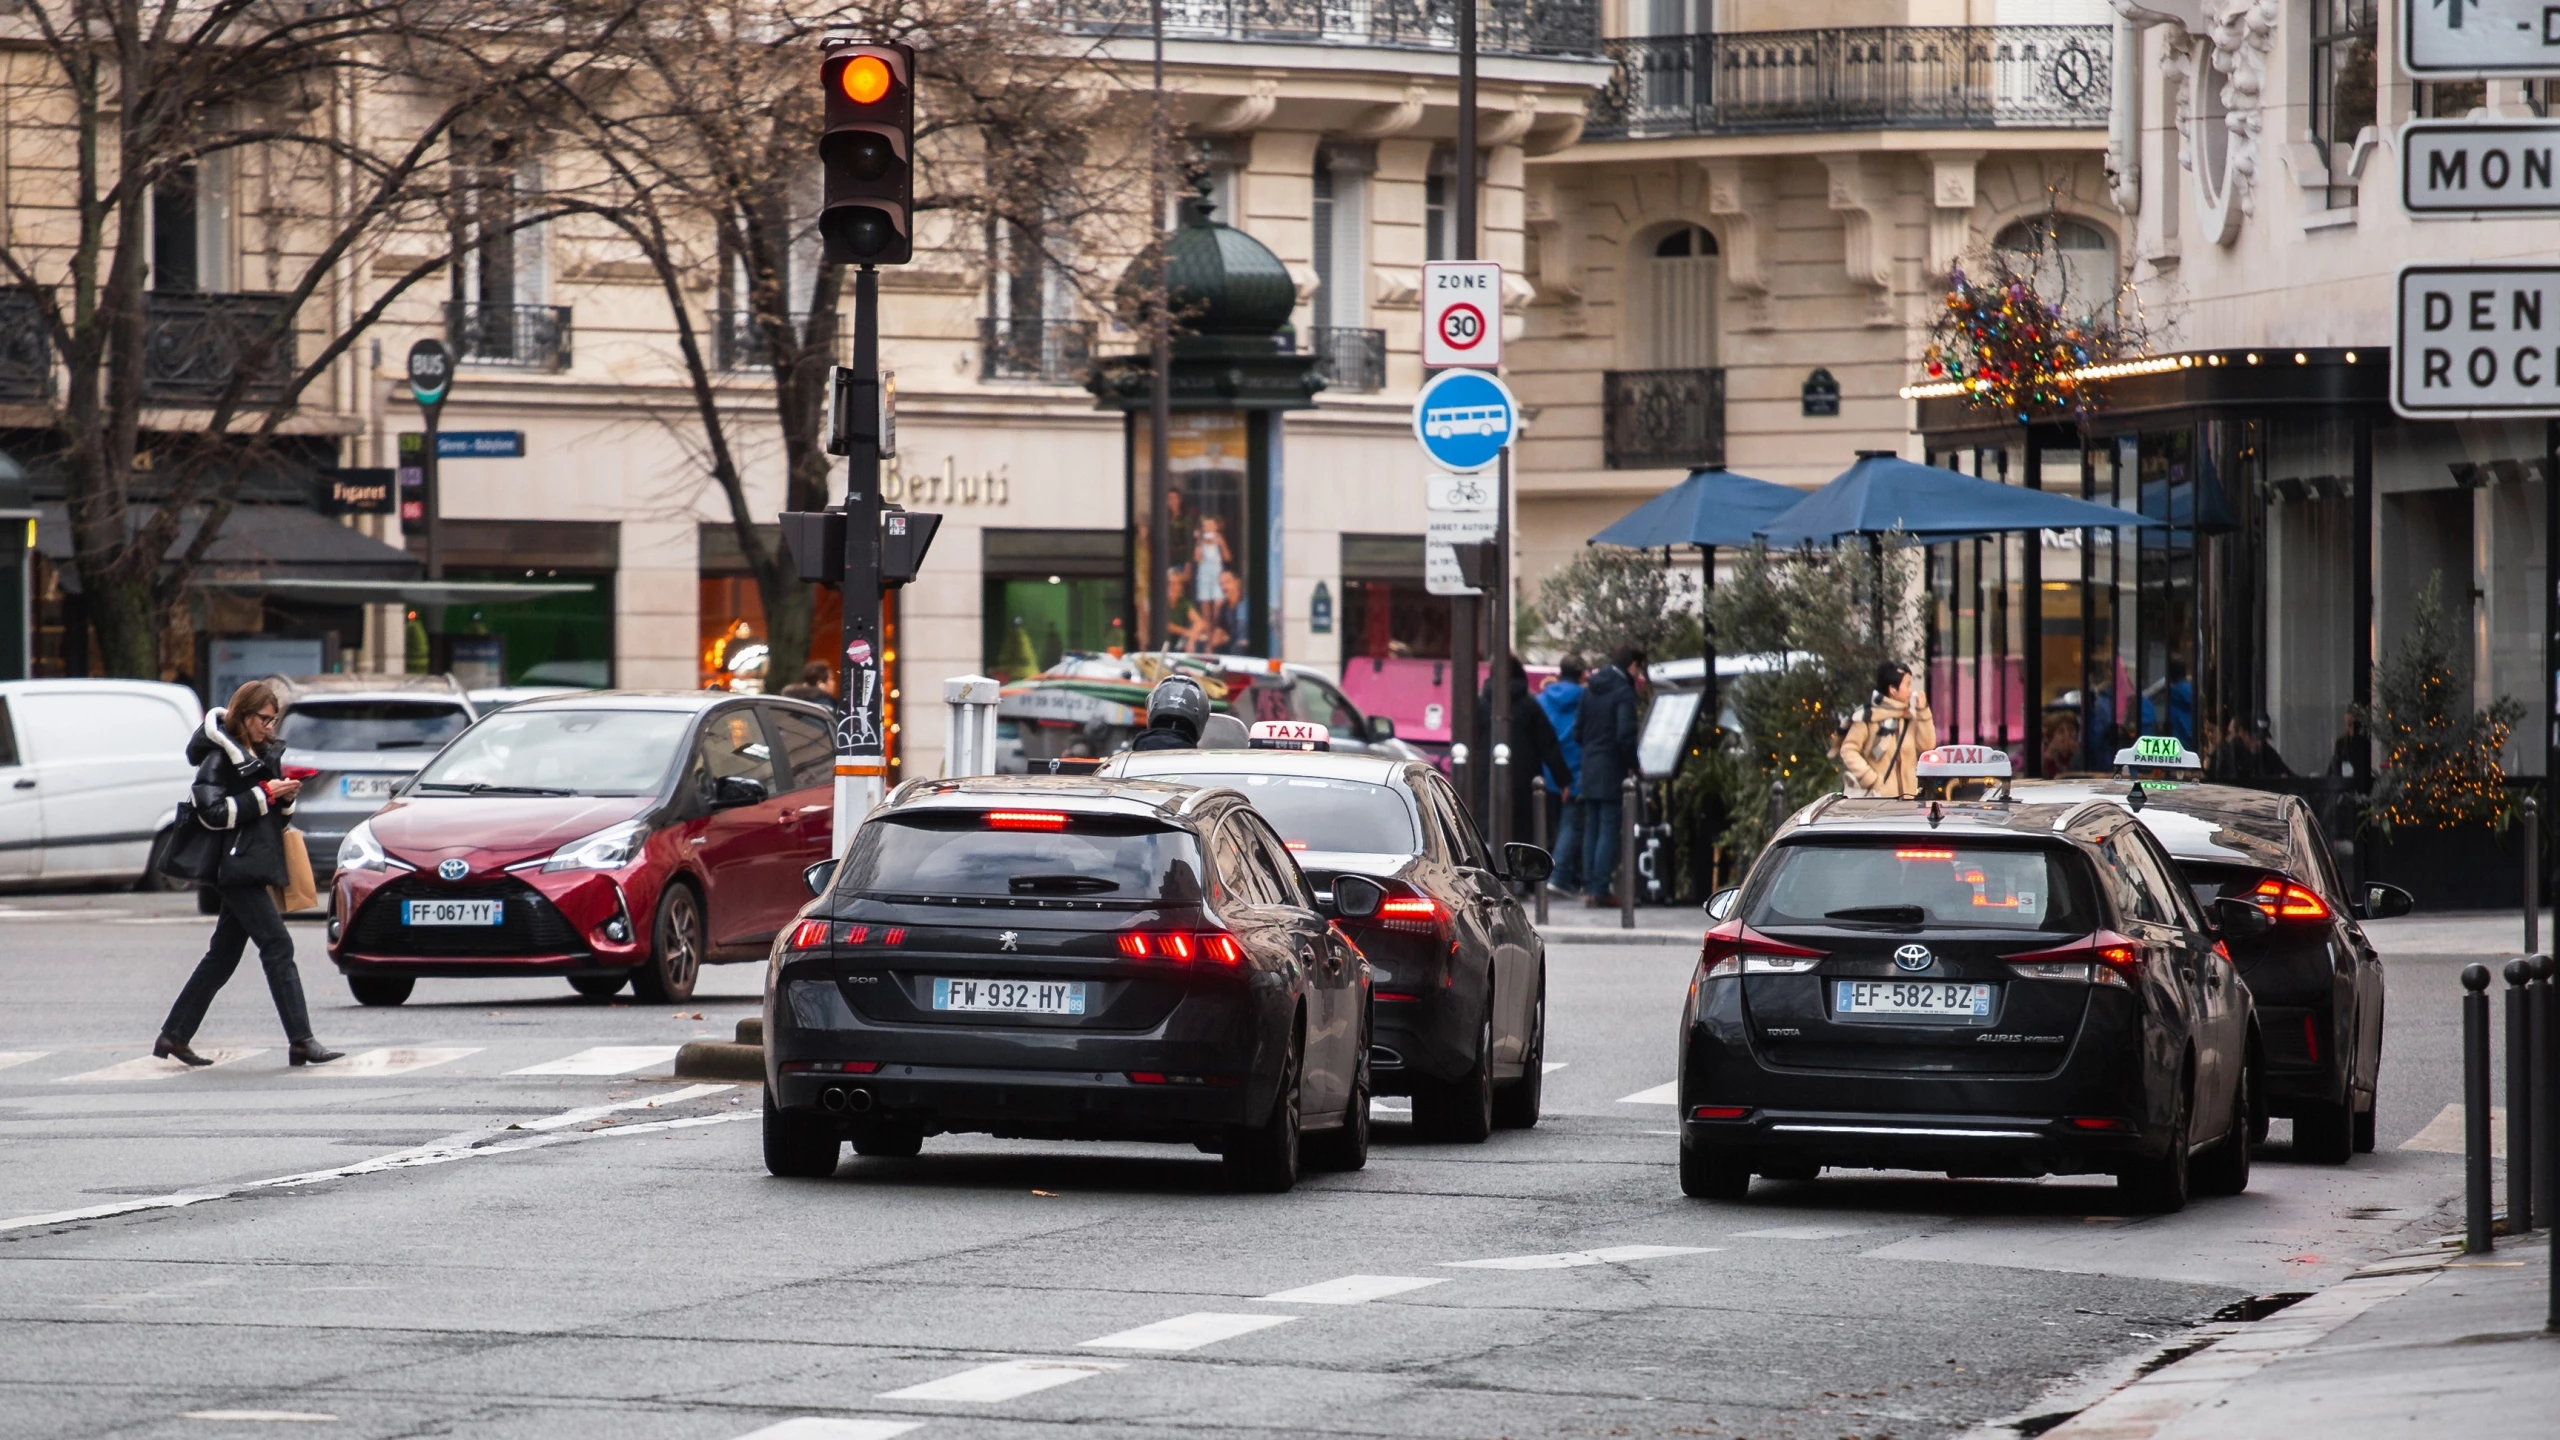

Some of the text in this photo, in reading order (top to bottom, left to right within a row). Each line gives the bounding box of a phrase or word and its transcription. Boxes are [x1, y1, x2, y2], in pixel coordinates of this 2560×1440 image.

[2429, 148, 2552, 190] MON
[1438, 275, 1487, 288] ZONE
[2424, 290, 2560, 332] DEN
[1447, 315, 1477, 337] 30
[412, 354, 445, 375] BUS
[2423, 347, 2560, 388] ROC
[881, 452, 1008, 505] Berluti
[1266, 725, 1312, 739] TAXI
[2141, 739, 2176, 755] TAXI
[1943, 748, 1983, 764] TAXI
[2134, 754, 2182, 764] PARISIEN
[923, 896, 1102, 908] PEUGEOT
[412, 904, 490, 921] FF-067-YY
[848, 976, 878, 984] 508
[950, 981, 1066, 1009] FW-932-HY
[1854, 983, 1972, 1009] EF-582-BZ
[1070, 1000, 1082, 1011] 89
[1975, 1000, 1987, 1011] 75
[1767, 1028, 1801, 1036] TOYOTA
[1976, 1034, 2023, 1042] AURIS
